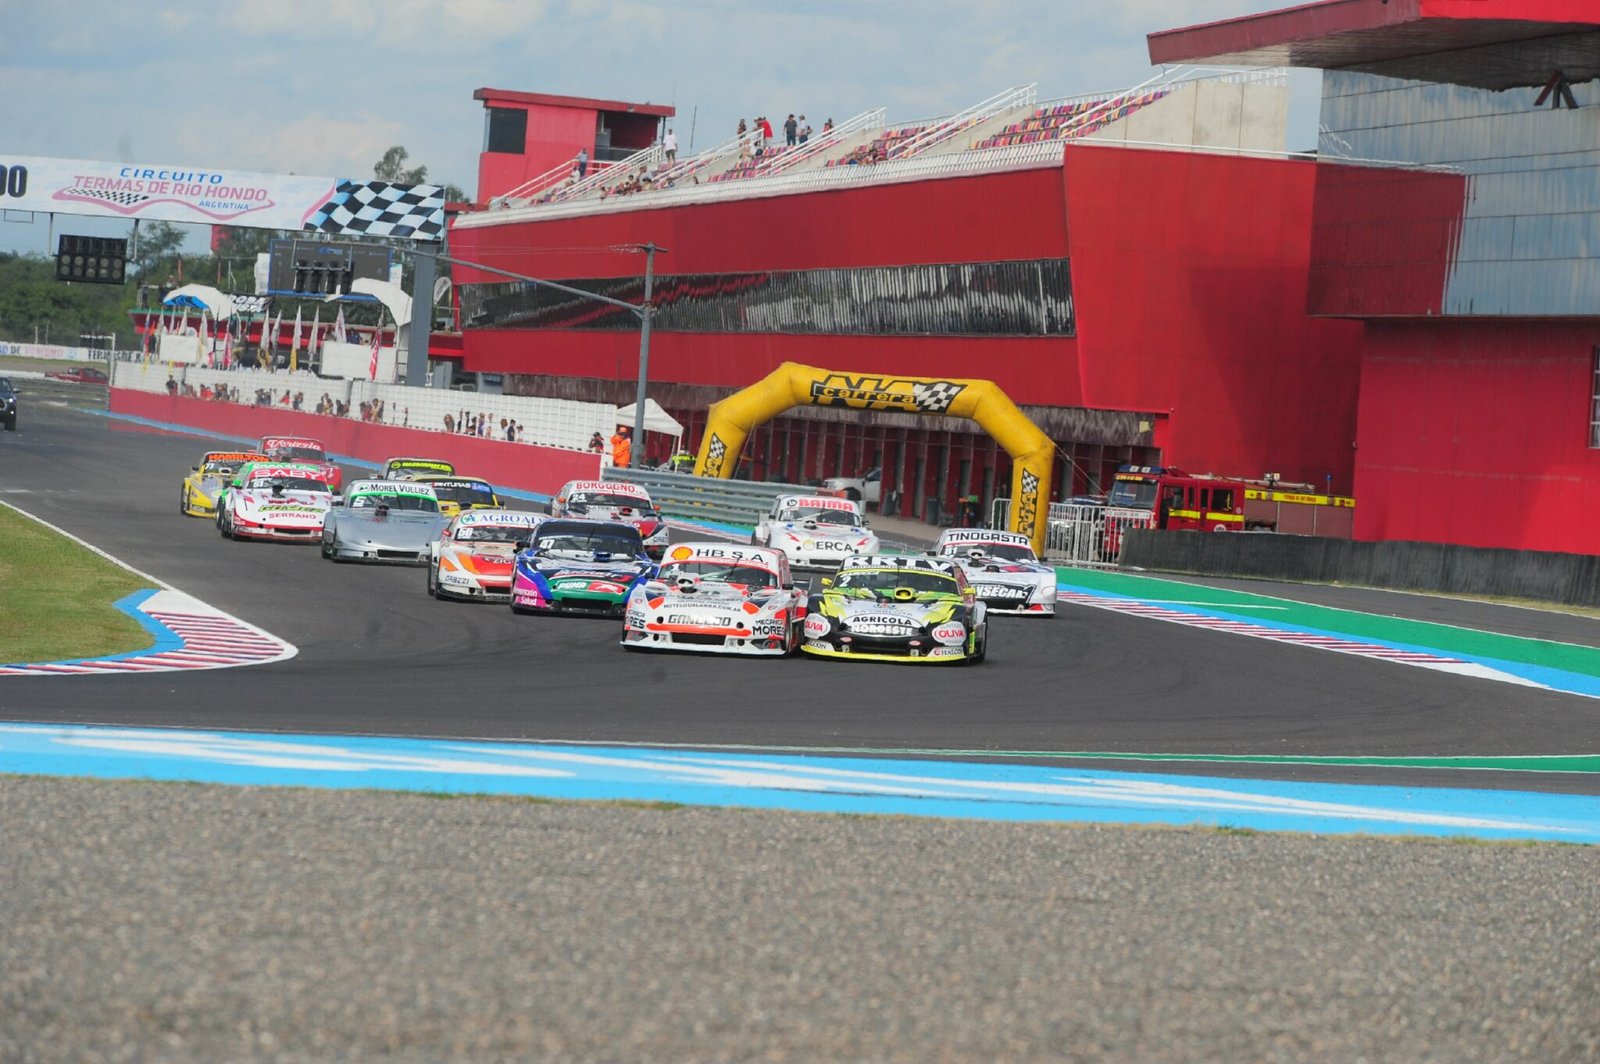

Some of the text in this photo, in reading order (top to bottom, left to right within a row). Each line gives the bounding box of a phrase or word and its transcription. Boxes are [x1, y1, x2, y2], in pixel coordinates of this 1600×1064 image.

[119, 167, 223, 184] CIRCUITO
[74, 175, 144, 193] TERMAS
[147, 180, 169, 195] DE
[204, 185, 268, 202] HONDO
[198, 200, 249, 211] ARGENTINA
[823, 387, 915, 404] carrera
[254, 469, 322, 480] SABY
[398, 484, 430, 495] VULLIEZ
[576, 482, 636, 493] BORGOGNO
[949, 532, 1028, 545] TINOGASTA
[816, 541, 854, 552] ERCA
[696, 549, 725, 558] HB
[839, 576, 851, 587] 2
[853, 616, 912, 626] AGRICOLA
[850, 624, 913, 635] NOROESTE
[938, 630, 964, 638] OLIVA
